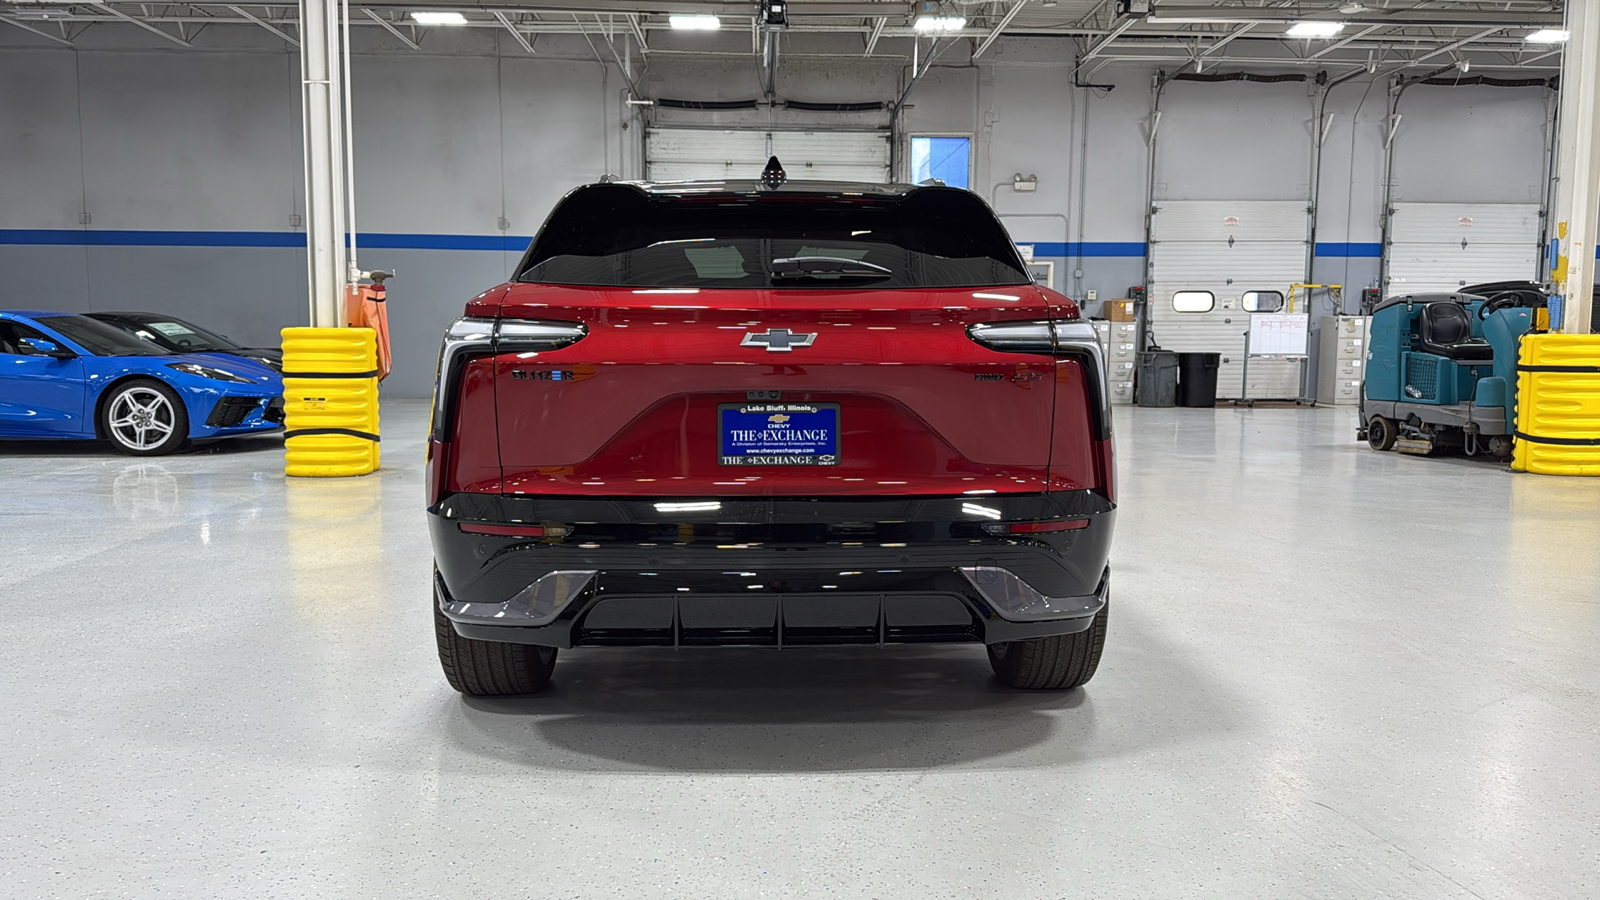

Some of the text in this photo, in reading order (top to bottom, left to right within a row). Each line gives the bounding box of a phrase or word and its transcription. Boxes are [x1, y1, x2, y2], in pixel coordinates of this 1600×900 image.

[731, 430, 828, 441] THE EXCHANGE
[722, 456, 812, 464] THE EXCHANGE
